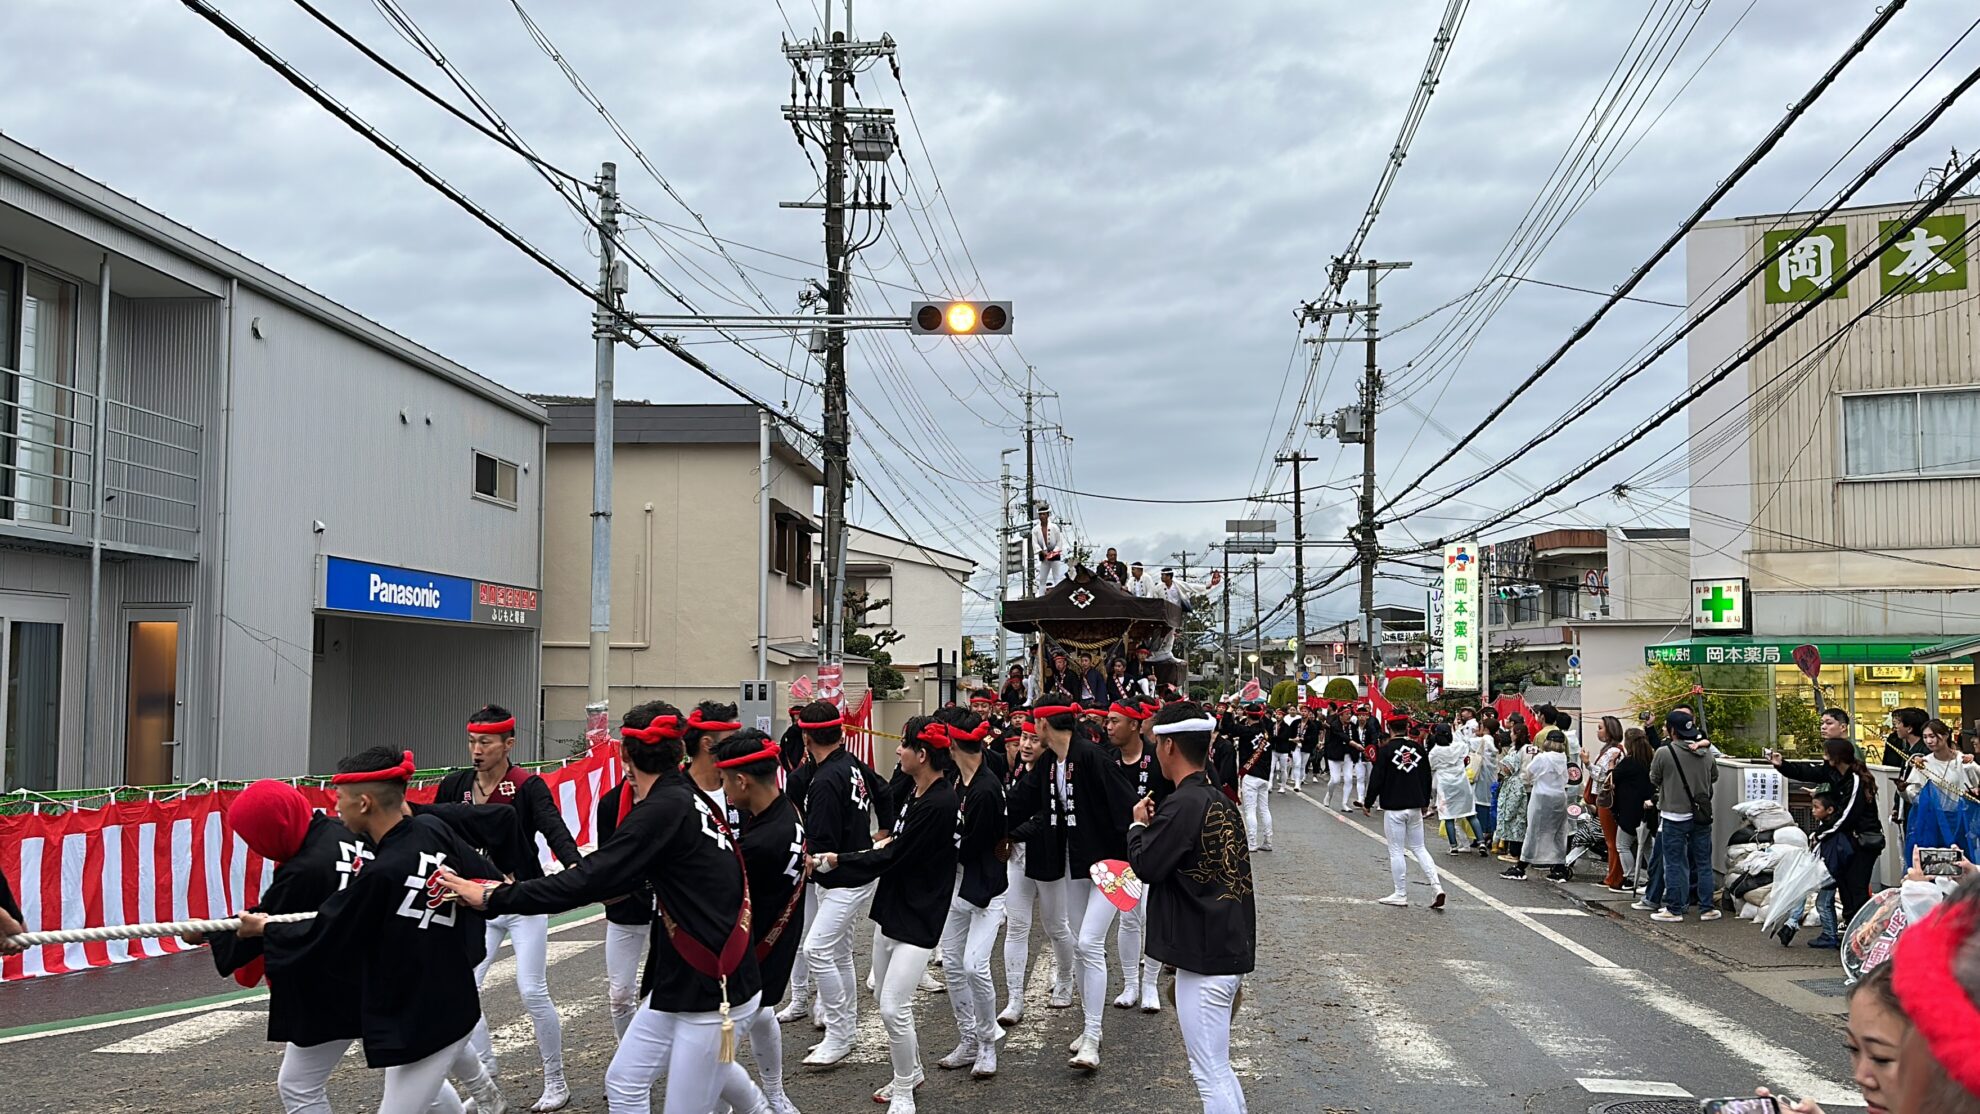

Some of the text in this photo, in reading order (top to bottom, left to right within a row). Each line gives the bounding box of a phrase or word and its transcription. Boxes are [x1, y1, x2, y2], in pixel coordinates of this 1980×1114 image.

[1778, 226, 1956, 293] 岡本
[369, 573, 440, 609] Panasonic
[1454, 577, 1468, 662] 岡本薬局
[1696, 616, 1711, 624] 岡本
[1647, 646, 1780, 663] 処方せん受付 岡本薬局
